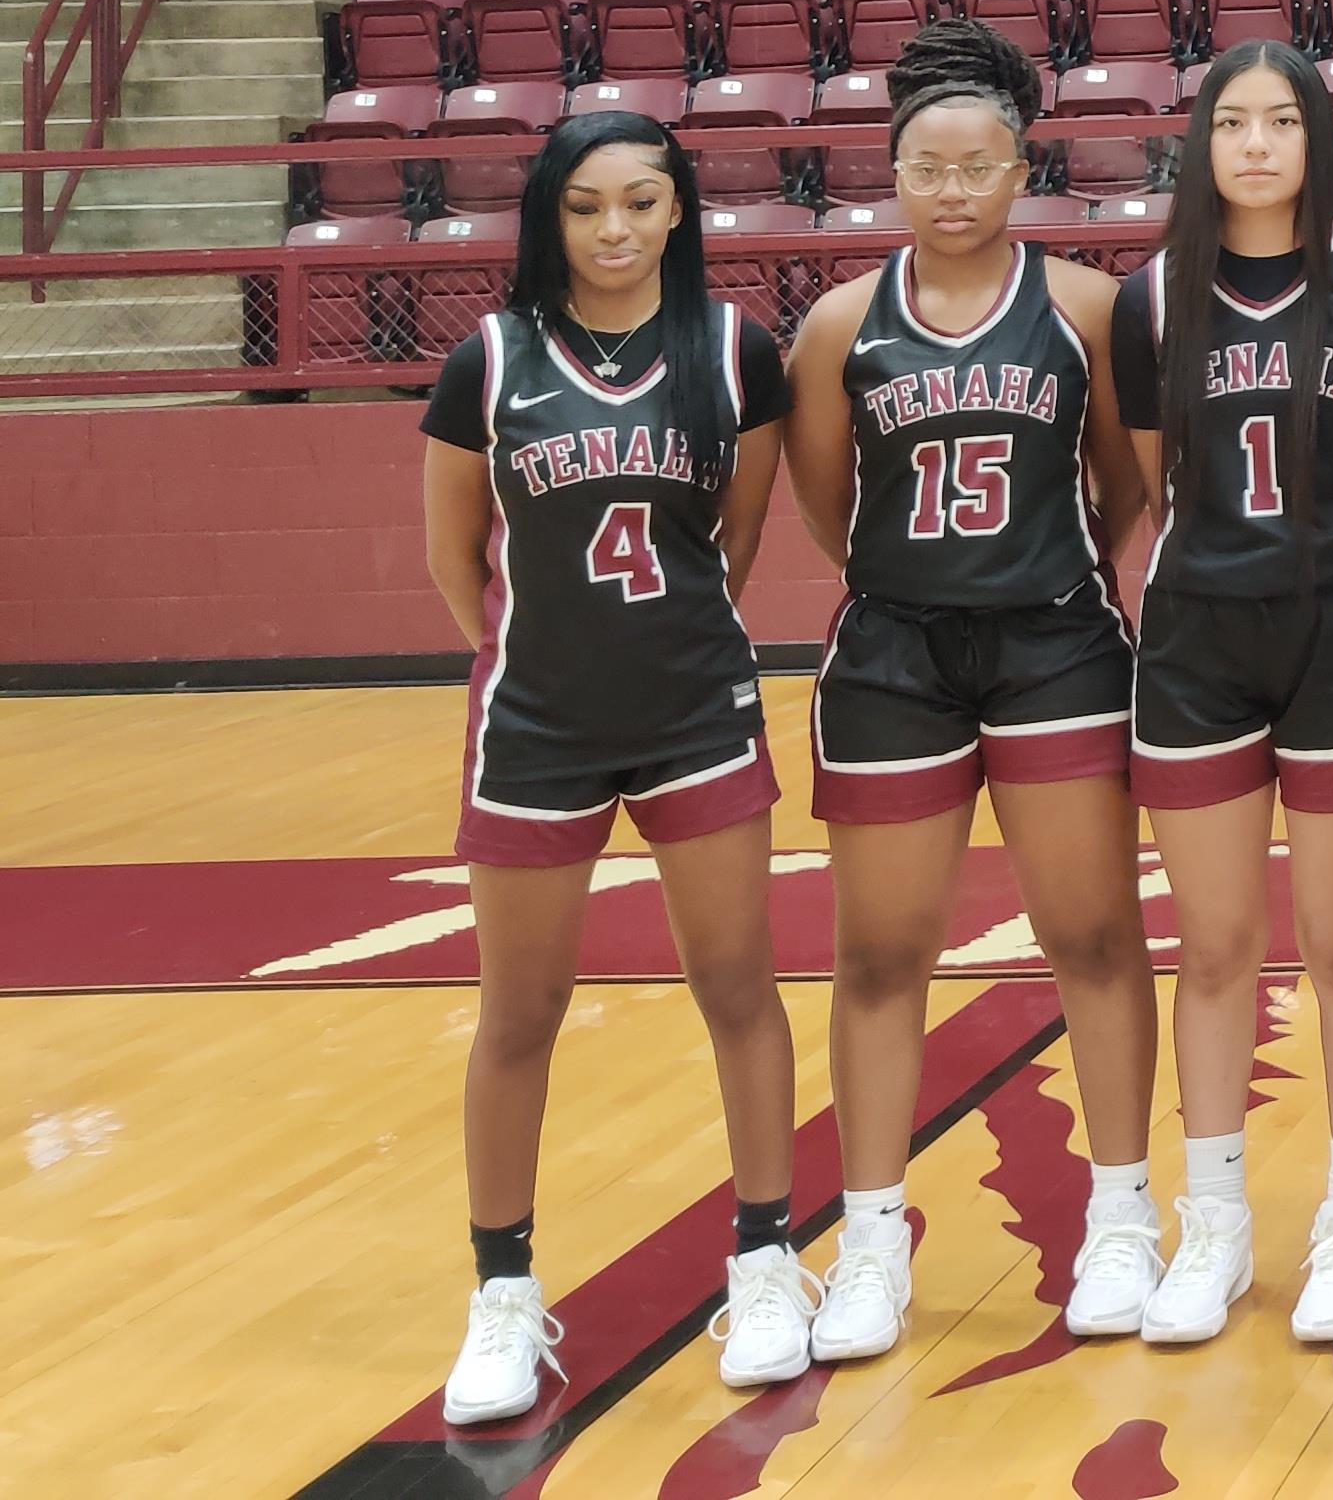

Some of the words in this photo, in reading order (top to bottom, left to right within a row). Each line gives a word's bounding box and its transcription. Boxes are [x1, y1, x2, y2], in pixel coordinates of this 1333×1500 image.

[864, 363, 1059, 436] TENAHA
[909, 434, 1014, 539] 15
[1239, 414, 1283, 518] 1
[586, 502, 667, 603] 4
